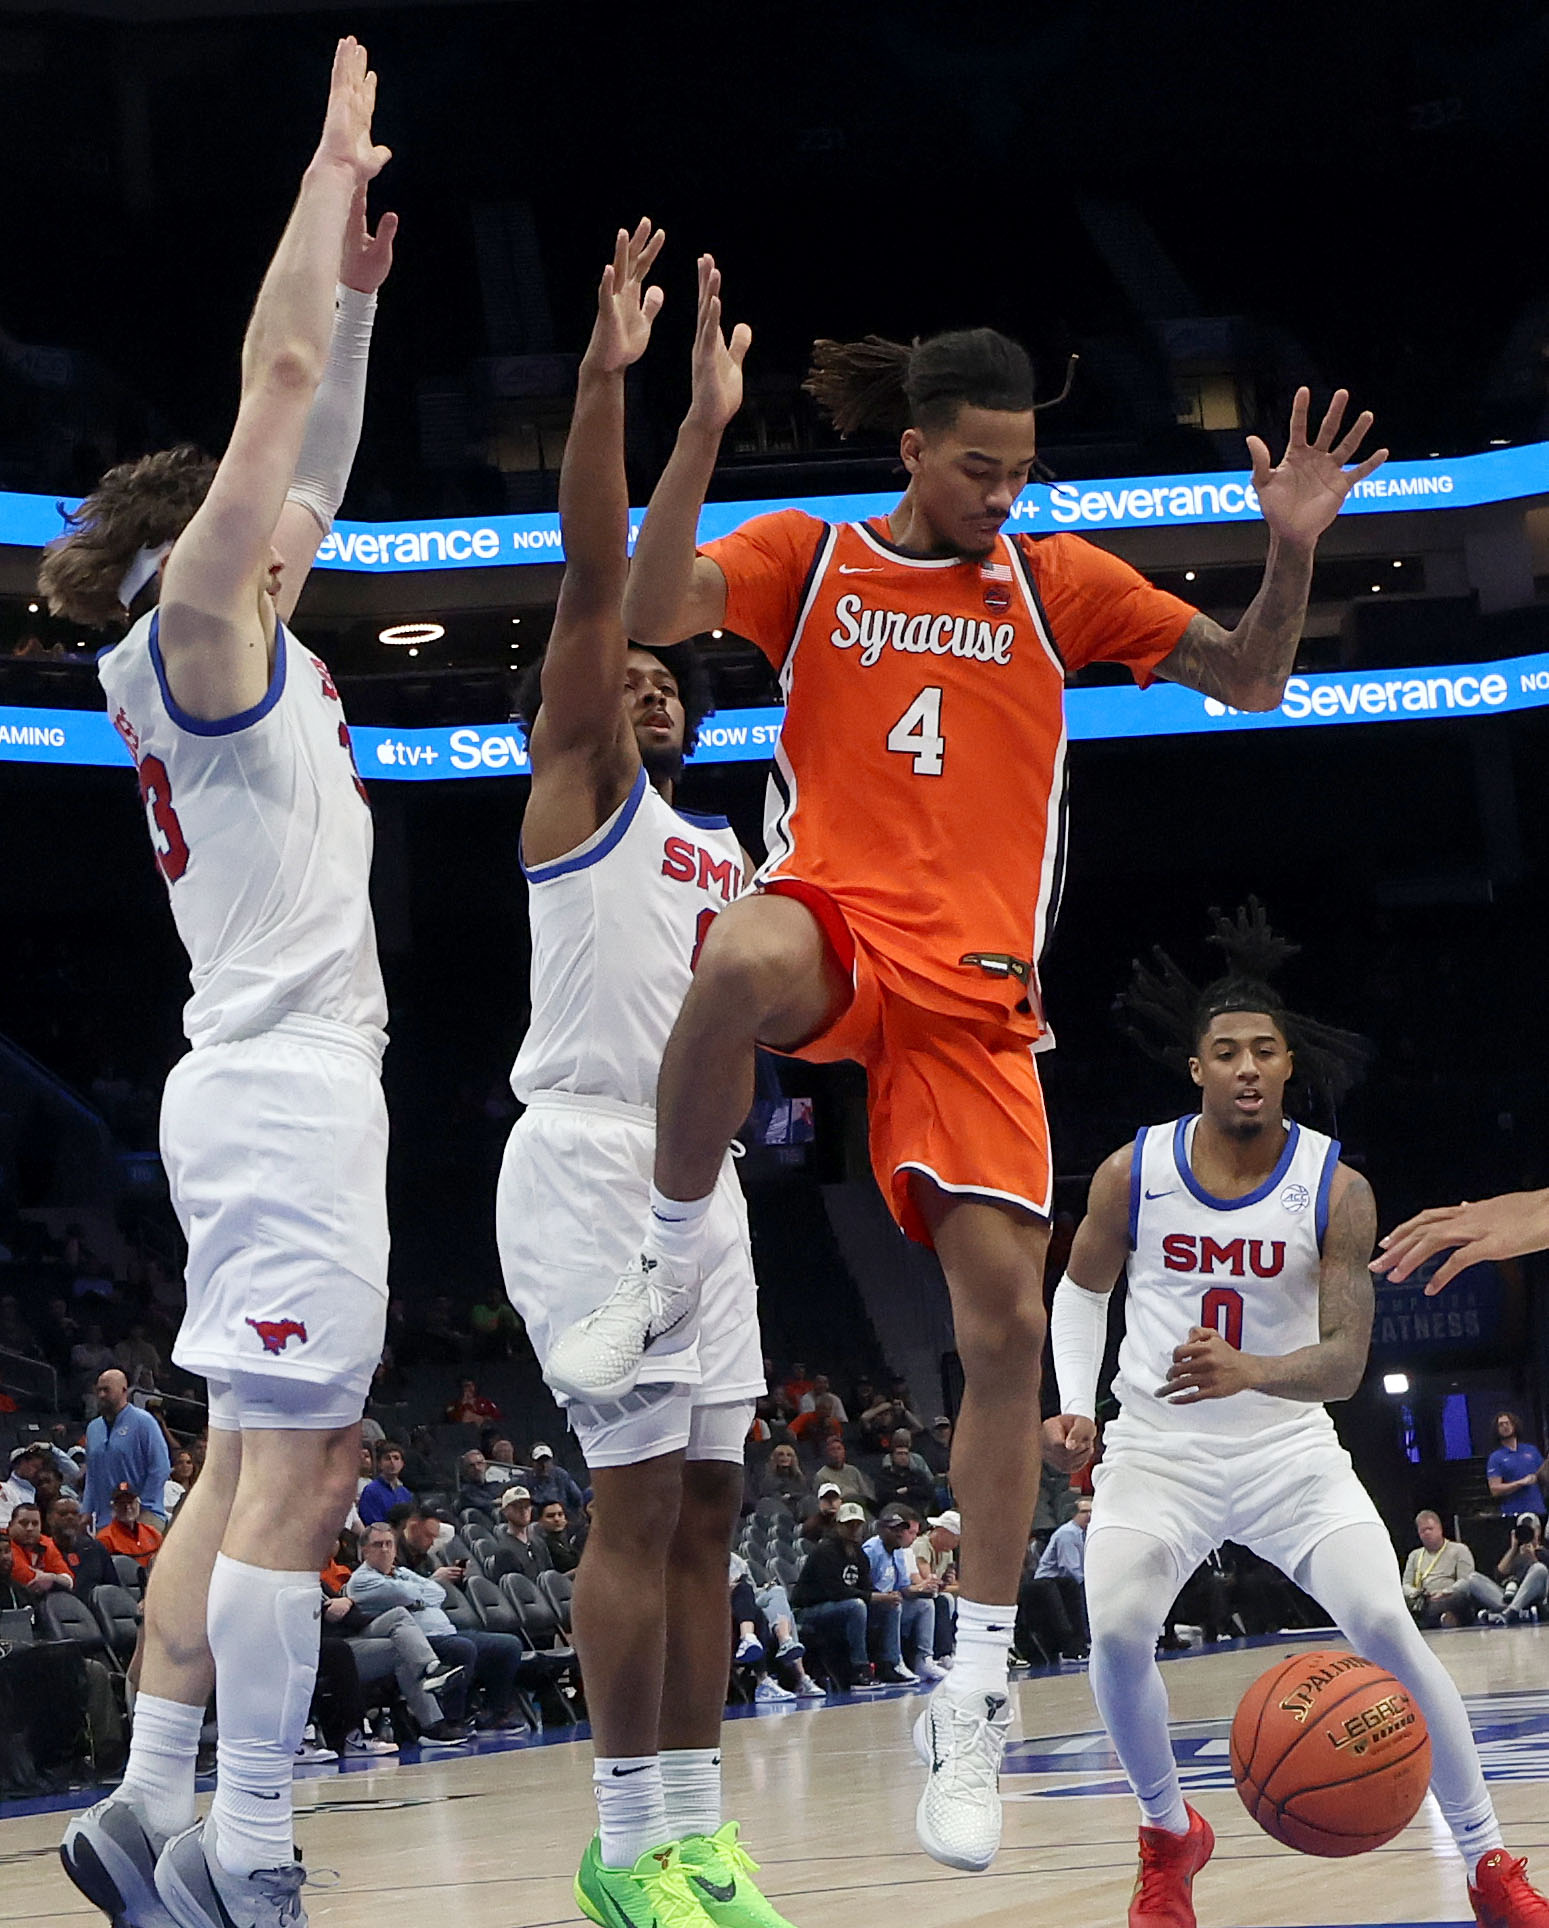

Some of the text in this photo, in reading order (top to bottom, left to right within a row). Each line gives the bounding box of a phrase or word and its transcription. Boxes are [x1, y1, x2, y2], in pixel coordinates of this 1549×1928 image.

[1009, 499, 1040, 520] v+
[1345, 475, 1454, 499] TREAMING
[315, 528, 562, 565] everance NOW
[830, 593, 1015, 667] Syracuse
[1281, 671, 1549, 719] Severance NO
[0, 725, 66, 747] AMING
[449, 729, 528, 770] Sev
[698, 727, 748, 748] NOW
[886, 685, 946, 776] 4
[661, 836, 741, 903] SM
[1162, 1233, 1287, 1278] SMU
[1201, 1287, 1244, 1351] 0
[1376, 1310, 1481, 1343] ATNESS
